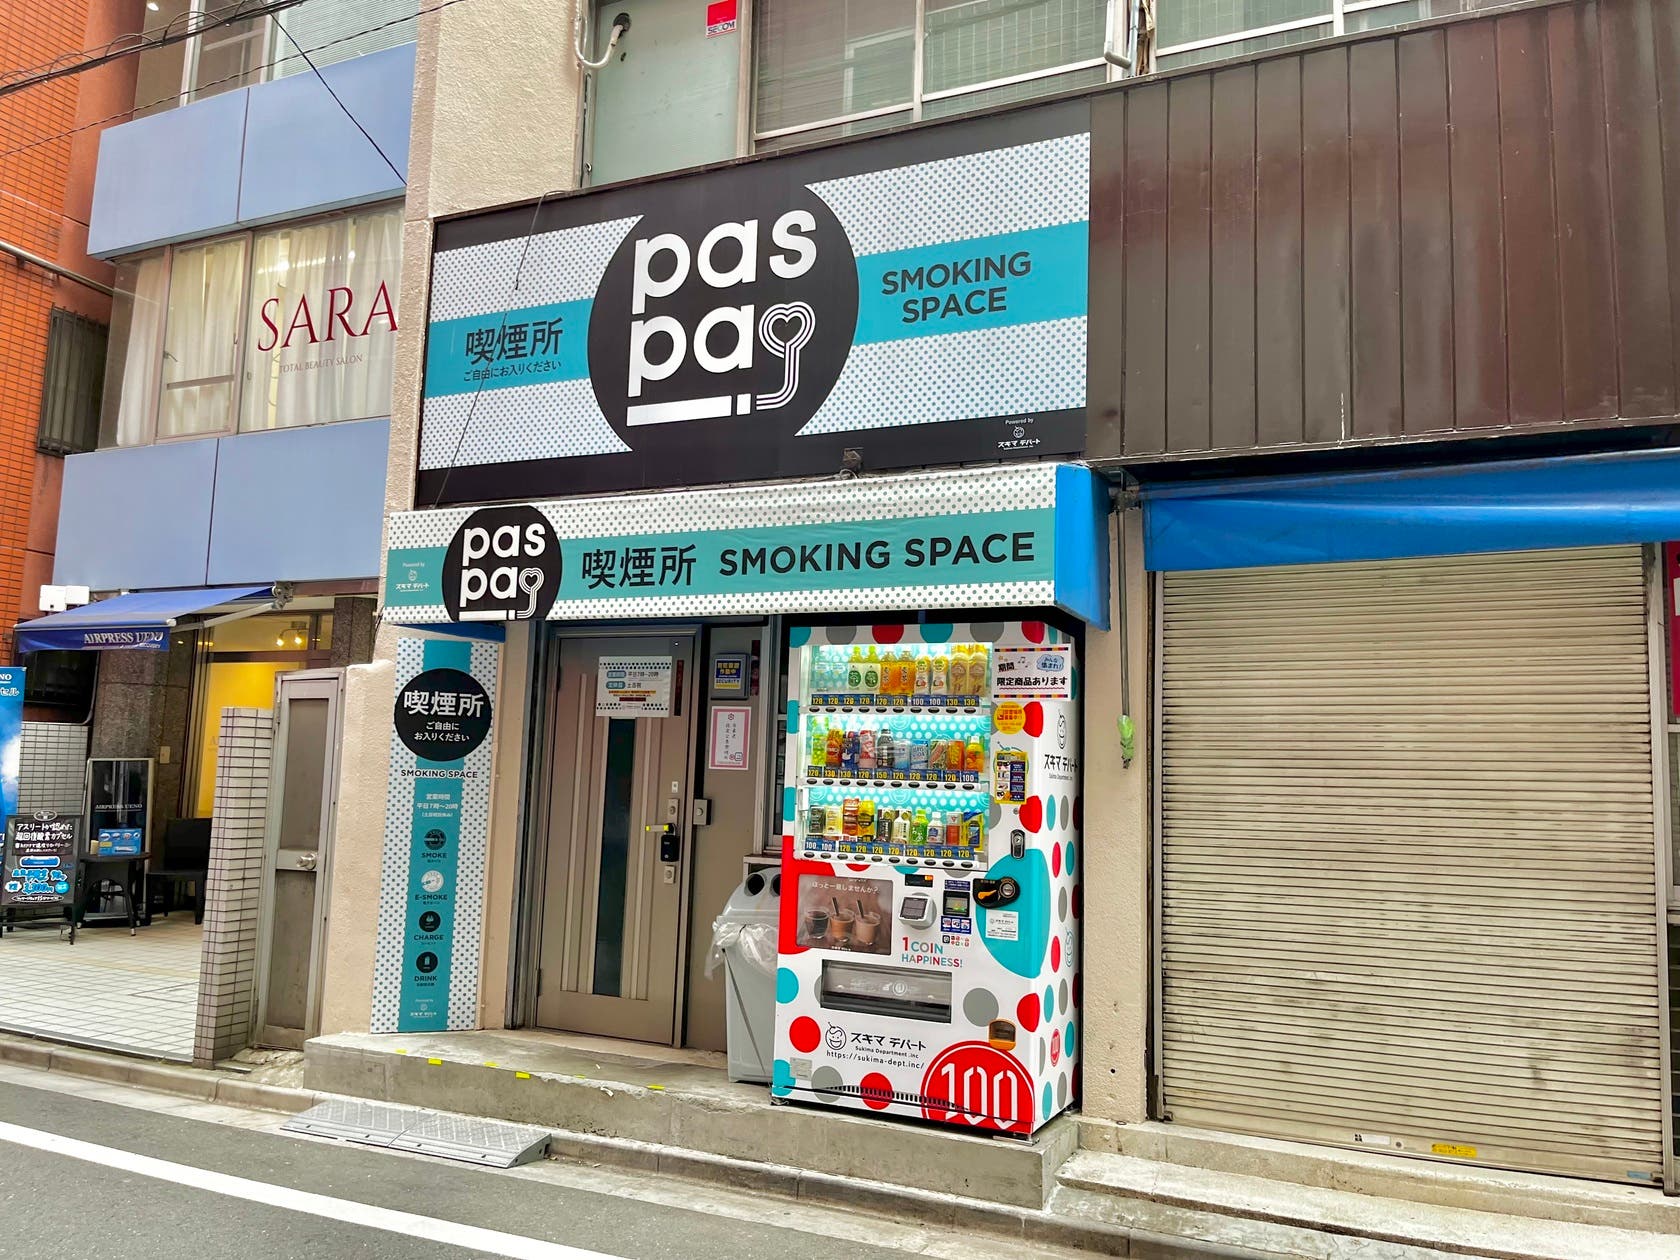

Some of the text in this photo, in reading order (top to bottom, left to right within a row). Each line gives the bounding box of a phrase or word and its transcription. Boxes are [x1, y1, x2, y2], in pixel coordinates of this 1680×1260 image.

[632, 209, 817, 315] pas
[881, 251, 1032, 295] SMOKING
[902, 286, 1008, 324] SPACE
[257, 279, 399, 352] SARA
[465, 316, 564, 365] 喫煙所
[280, 353, 363, 374] TOTAL BEAUTY SALON
[463, 359, 562, 382] ご自由にお入りください
[462, 523, 546, 567] pas
[719, 531, 1036, 577] SMOKING SPACE
[581, 543, 697, 589] 喫煙所
[84, 632, 134, 644] AIRPRESS
[998, 662, 1015, 672] 期間
[997, 676, 1068, 686] 限定商品あります
[404, 690, 484, 718] 喫煙所
[426, 721, 460, 731] ご自由に
[414, 732, 470, 742] お入りください
[1044, 754, 1062, 770] スキマ
[401, 769, 479, 779] SMOKING SPACE
[825, 769, 835, 777] 130
[858, 770, 869, 778] 120
[876, 771, 887, 779] 150
[893, 771, 904, 780] 120
[909, 772, 920, 780] 120
[926, 773, 937, 781] 120
[945, 773, 956, 781] 120
[963, 774, 974, 782] 100
[840, 844, 850, 852] 120
[907, 848, 918, 856] 120
[923, 849, 934, 857] 120
[941, 849, 952, 857] 120
[958, 850, 969, 858] 120
[903, 937, 944, 954] 1 COIN
[901, 954, 963, 968] HAPPINESS!
[851, 1032, 927, 1052] スキマ デパート
[826, 1050, 925, 1069] https://sukima-dept.inc/
[875, 1048, 908, 1058] Department
[941, 1062, 1018, 1130] 100
